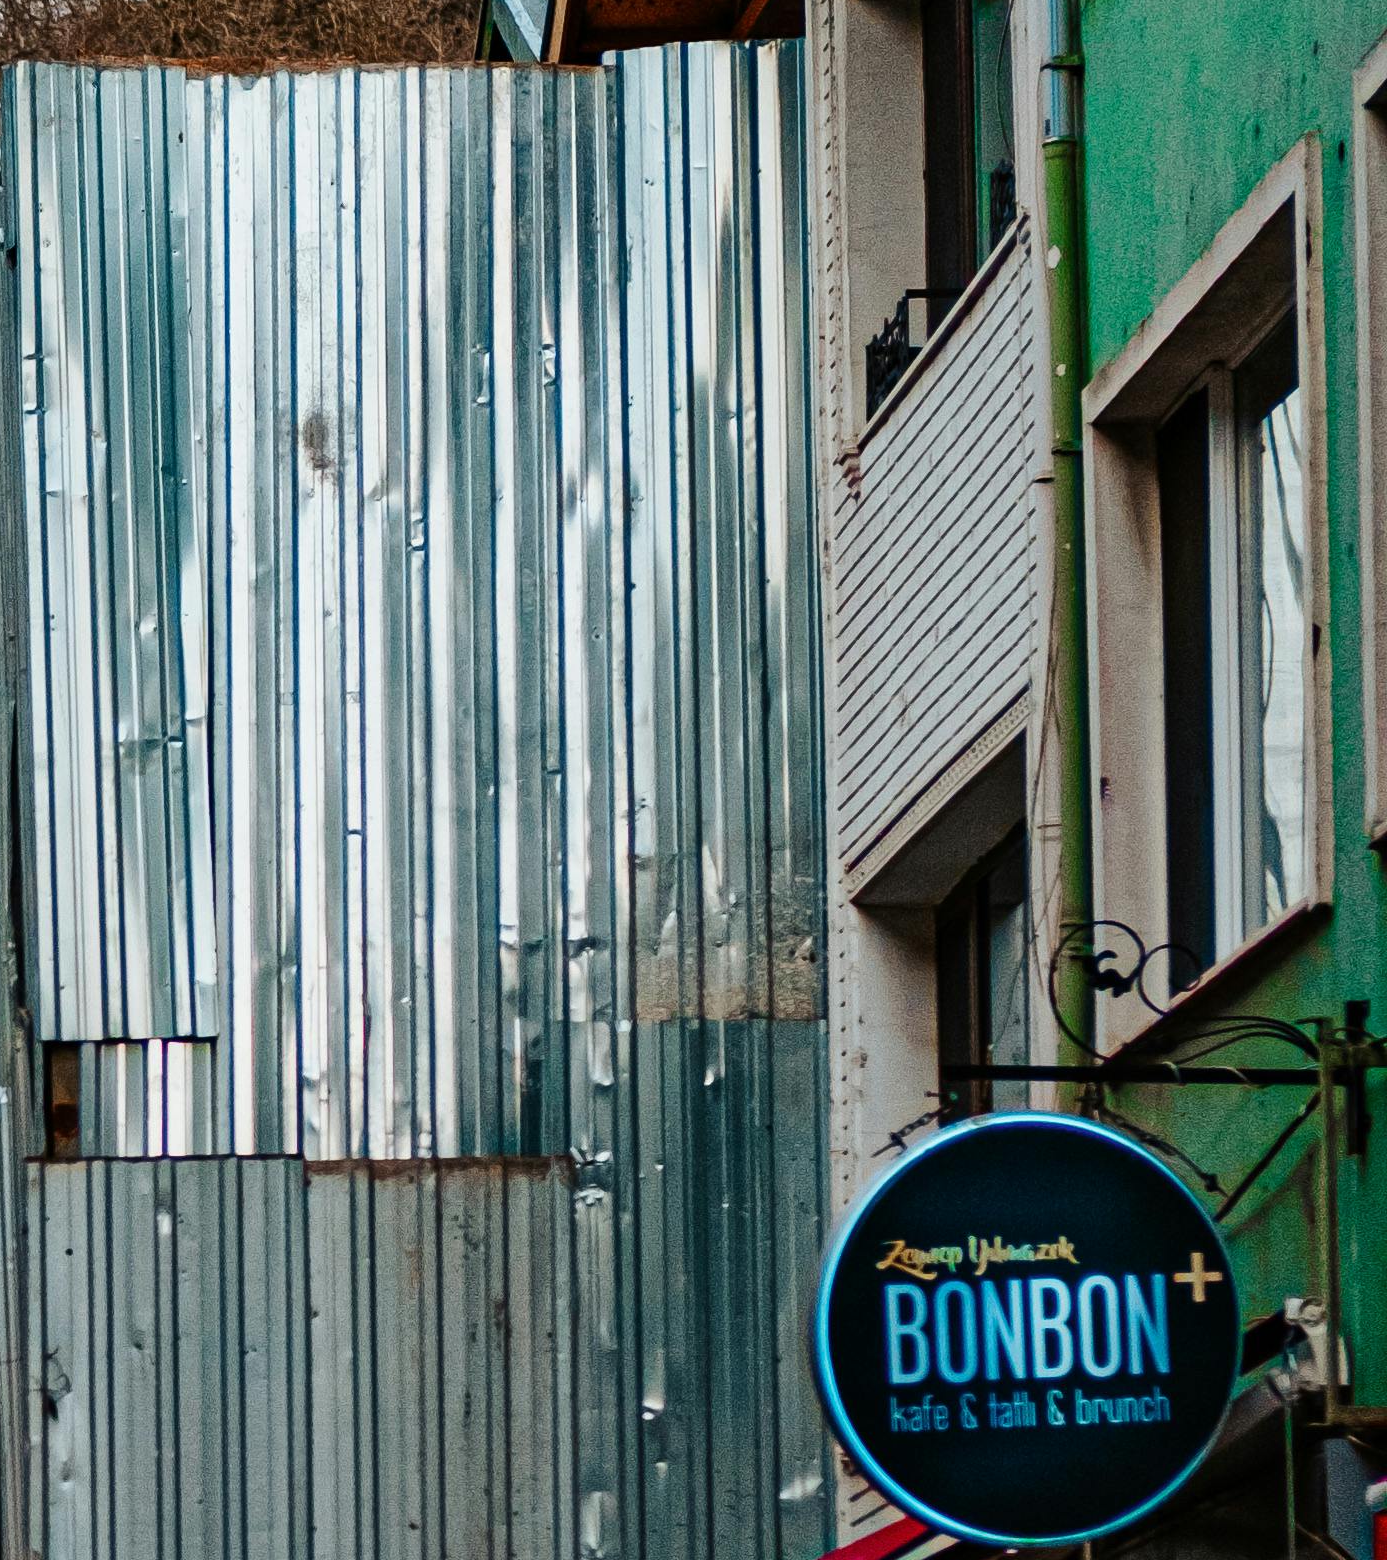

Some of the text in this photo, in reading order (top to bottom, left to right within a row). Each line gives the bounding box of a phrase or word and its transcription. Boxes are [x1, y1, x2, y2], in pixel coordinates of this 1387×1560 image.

[884, 1274, 1171, 1385] BONBON
[890, 1394, 949, 1432] kafe
[959, 1392, 978, 1429] &
[1047, 1389, 1066, 1426] &
[1076, 1386, 1171, 1425] brunch
